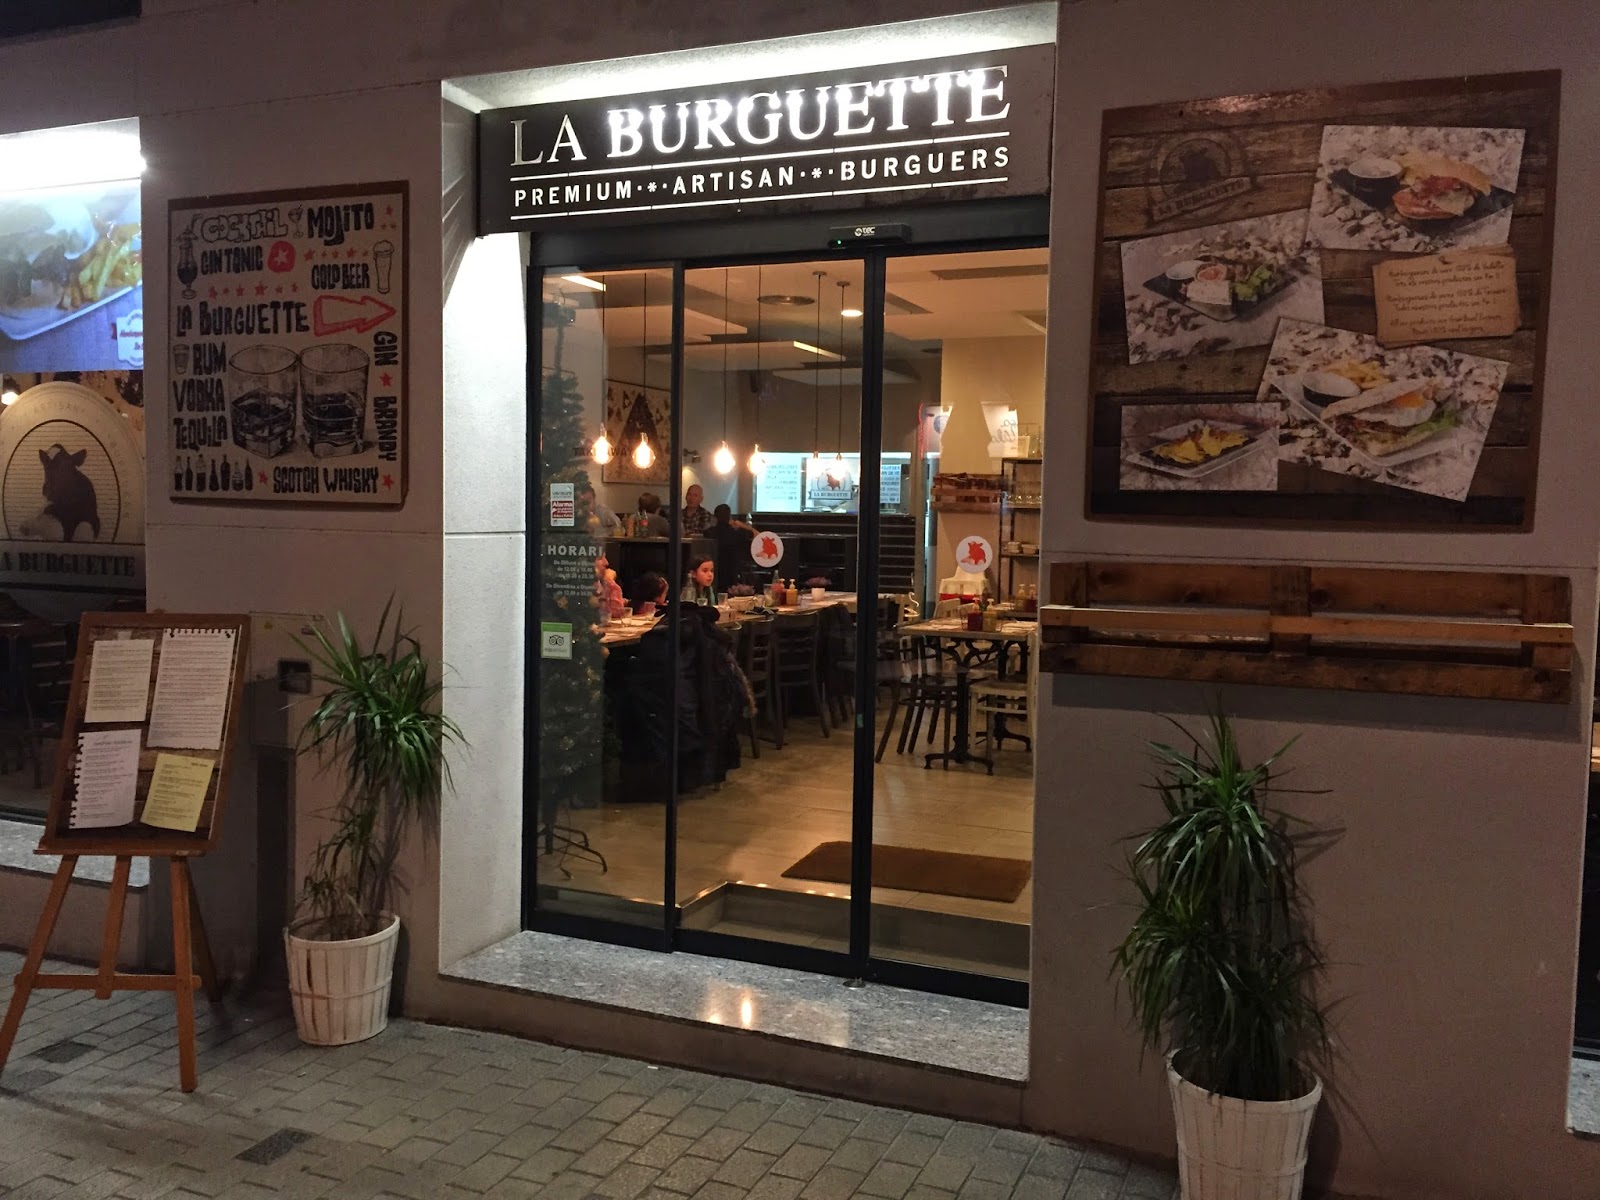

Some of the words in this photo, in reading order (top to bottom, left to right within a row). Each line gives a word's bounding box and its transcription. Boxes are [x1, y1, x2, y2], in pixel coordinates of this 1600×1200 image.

[511, 115, 587, 166] LA
[606, 66, 1010, 158] BURGUETTE
[514, 180, 632, 207] PREMIUM
[673, 167, 795, 196] ARTISAN
[840, 147, 1010, 181] BURGUERS
[311, 264, 340, 290] COLD
[342, 263, 370, 289] BEER
[176, 304, 192, 337] LA
[193, 342, 226, 375] RUM
[373, 331, 398, 366] GIN
[173, 378, 225, 412] VODKA
[273, 466, 319, 494] SCOTCH
[323, 467, 379, 493] WHISKY
[19, 552, 135, 577] BURGUETTE
[547, 545, 603, 556] HORARI
